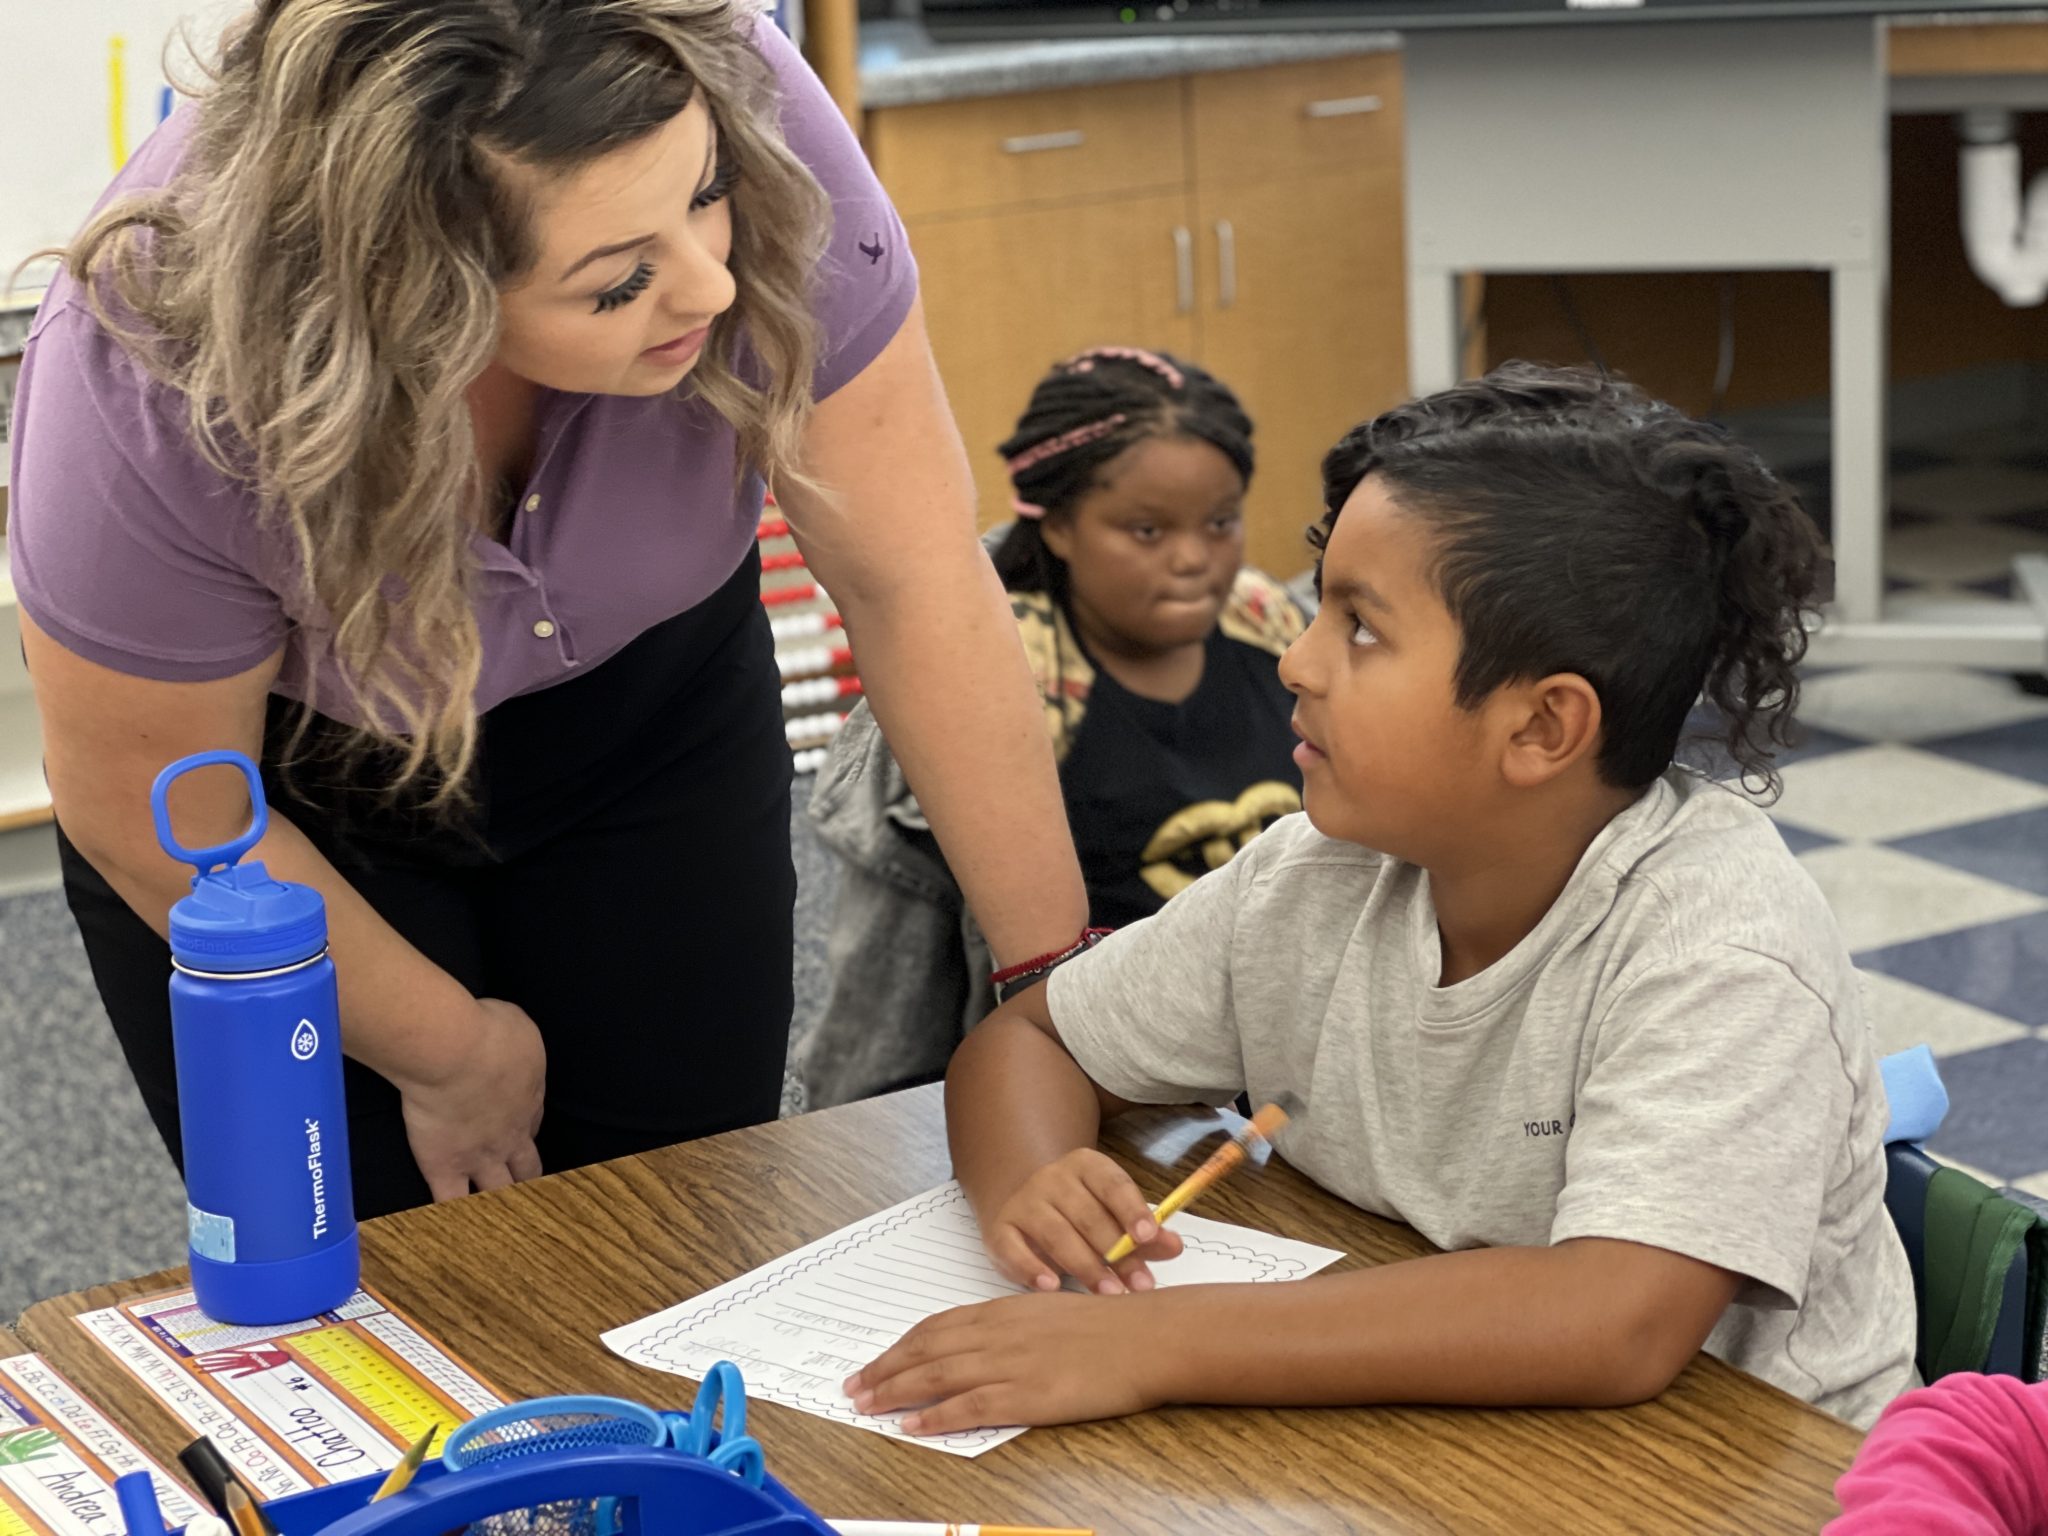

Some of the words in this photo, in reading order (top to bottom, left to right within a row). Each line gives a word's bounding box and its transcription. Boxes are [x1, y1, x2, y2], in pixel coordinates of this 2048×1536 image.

[1523, 1120, 1563, 1137] YOUR
[306, 1119, 327, 1240] ThermoFlask
[21, 1370, 45, 1384] Bb
[36, 1383, 59, 1397] Cc
[60, 1405, 88, 1418] Dd
[95, 1440, 122, 1456] Gg
[216, 1417, 237, 1439] Qq
[230, 1436, 257, 1454] Pp
[38, 1470, 107, 1524] Andrea
